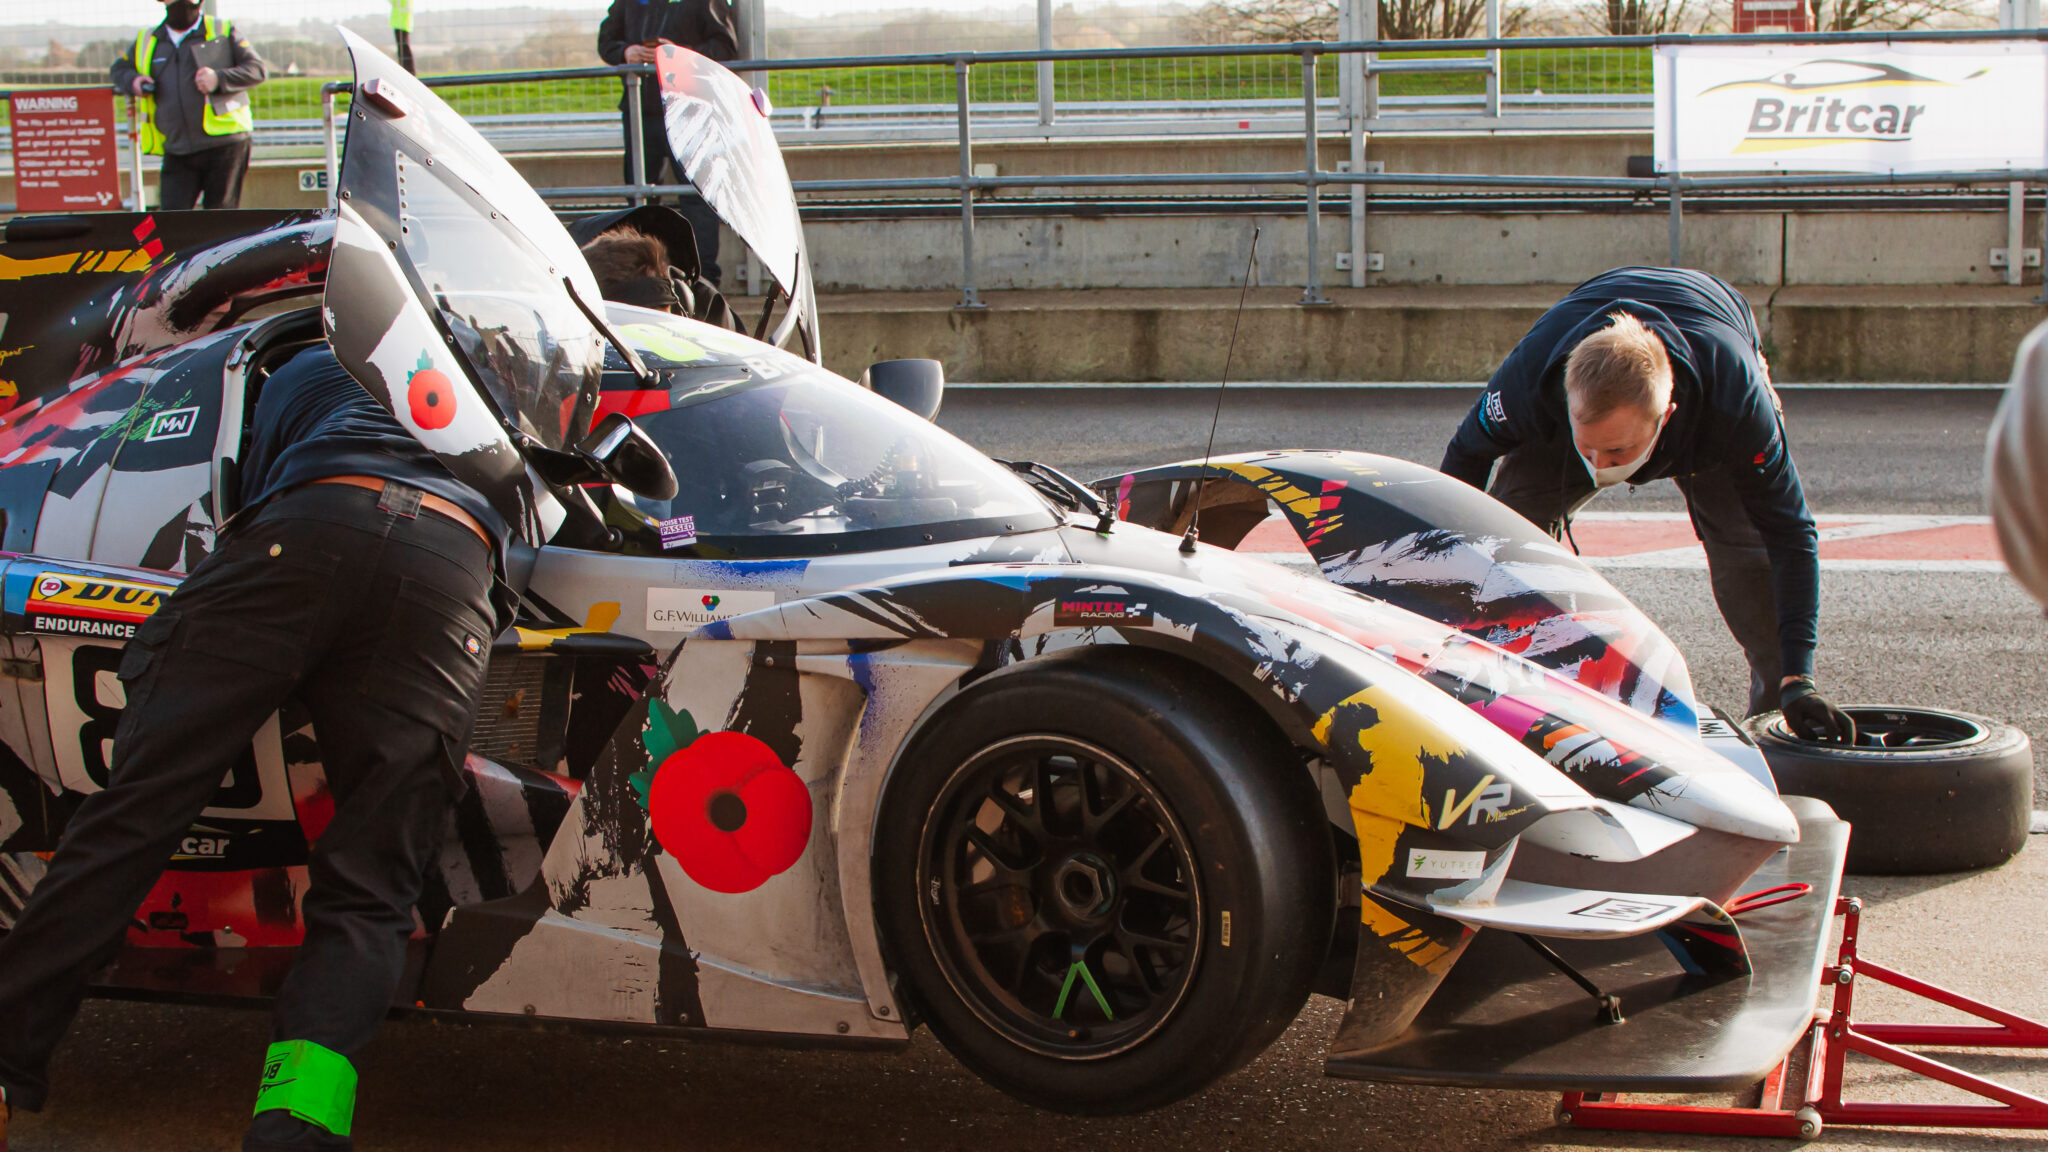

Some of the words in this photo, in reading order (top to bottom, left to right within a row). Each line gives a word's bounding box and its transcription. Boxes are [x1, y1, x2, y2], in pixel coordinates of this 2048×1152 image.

[15, 96, 78, 110] WARNING
[1748, 97, 1925, 134] Britcar
[156, 415, 189, 434] MW
[659, 518, 678, 527] NOISE
[678, 515, 694, 524] TEST
[661, 523, 694, 535] PASSED
[73, 583, 172, 606] DUN
[1062, 601, 1125, 612] MINTEX
[34, 616, 136, 638] ENDURANCE
[1437, 774, 1511, 830] VR
[180, 837, 230, 855] car
[1430, 860, 1482, 870] YUTREE
